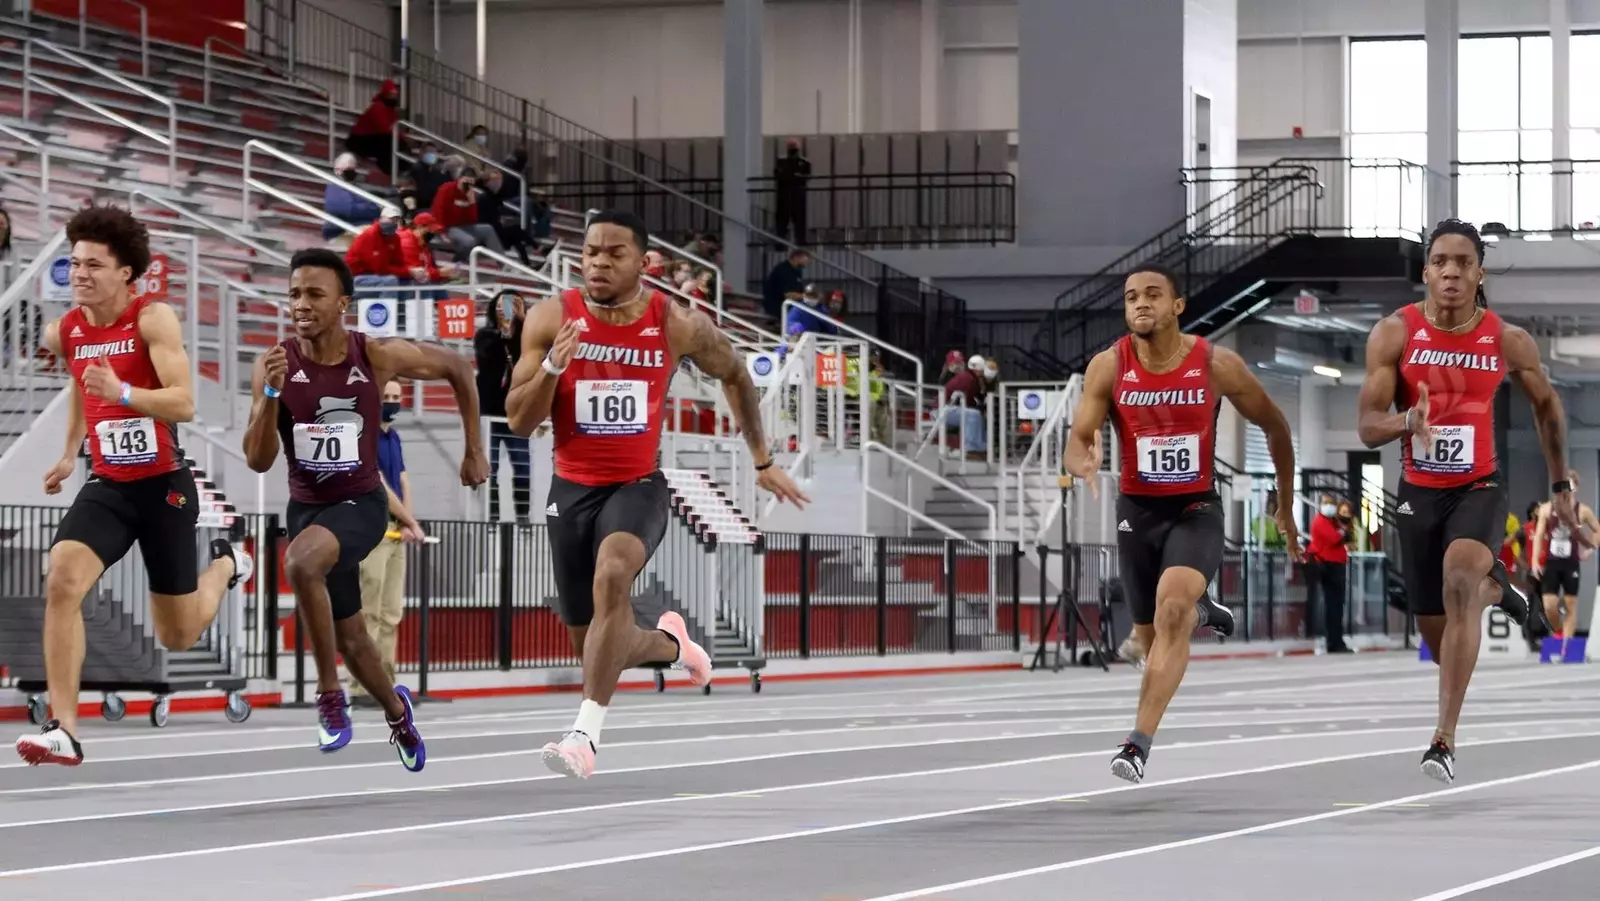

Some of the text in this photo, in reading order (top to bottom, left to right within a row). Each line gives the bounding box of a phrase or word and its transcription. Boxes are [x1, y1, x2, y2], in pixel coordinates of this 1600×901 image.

[444, 304, 469, 318] 110
[447, 321, 466, 334] 111
[638, 327, 660, 337] ACC
[1476, 335, 1495, 344] ACC
[572, 341, 664, 368] OUISVILLE
[1408, 348, 1499, 372] LOUISVILLE
[1183, 368, 1201, 378] ACC
[1119, 388, 1206, 406] LOUISVILLE
[587, 395, 637, 423] 160
[107, 429, 148, 455] 143
[1430, 427, 1461, 437] ileSplit
[310, 437, 341, 461] 70
[1147, 448, 1190, 472] 156
[1488, 609, 1510, 639] 8
